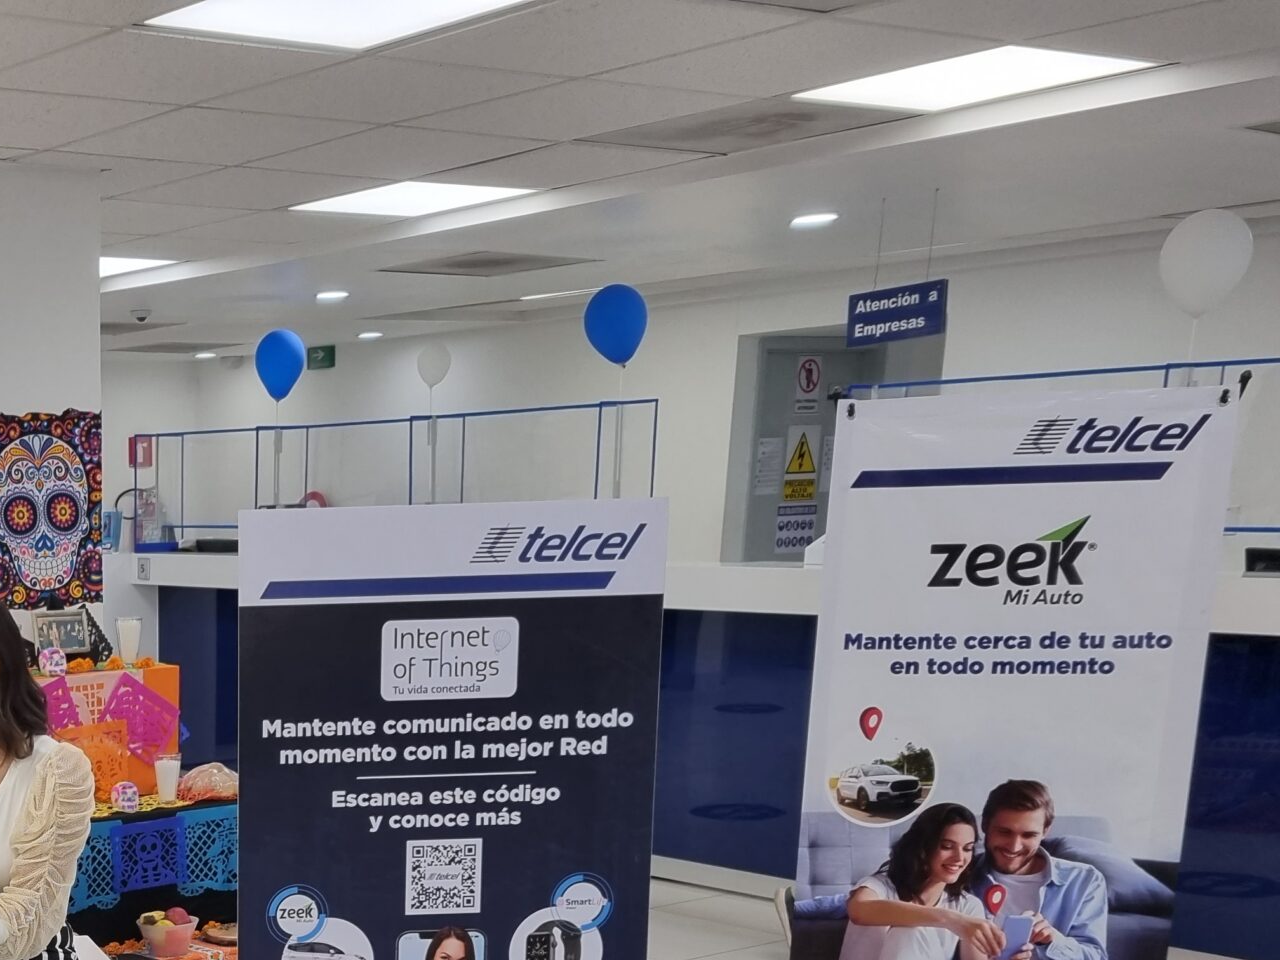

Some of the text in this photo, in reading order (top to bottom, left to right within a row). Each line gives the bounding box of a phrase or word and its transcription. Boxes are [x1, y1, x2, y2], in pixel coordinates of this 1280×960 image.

[855, 288, 938, 314] Atención a
[854, 315, 925, 338] Empresas
[1067, 413, 1212, 454] telcel
[518, 523, 647, 563] telcel
[140, 564, 145, 574] 5
[927, 540, 1090, 587] zeek
[1003, 589, 1083, 605] Mi Auto
[393, 625, 490, 652] Internet
[844, 631, 1173, 651] Mantente cerca de tu auto
[393, 656, 500, 684] of Things
[890, 656, 1115, 675] en todo momento
[393, 683, 481, 694] Tu vida conectada
[262, 708, 634, 738] Mantente comunicado en todo
[279, 736, 608, 765] momento con la mejor Red
[331, 784, 561, 808] Escanea este código
[369, 807, 522, 832] y conoce más
[279, 904, 315, 920] zeek
